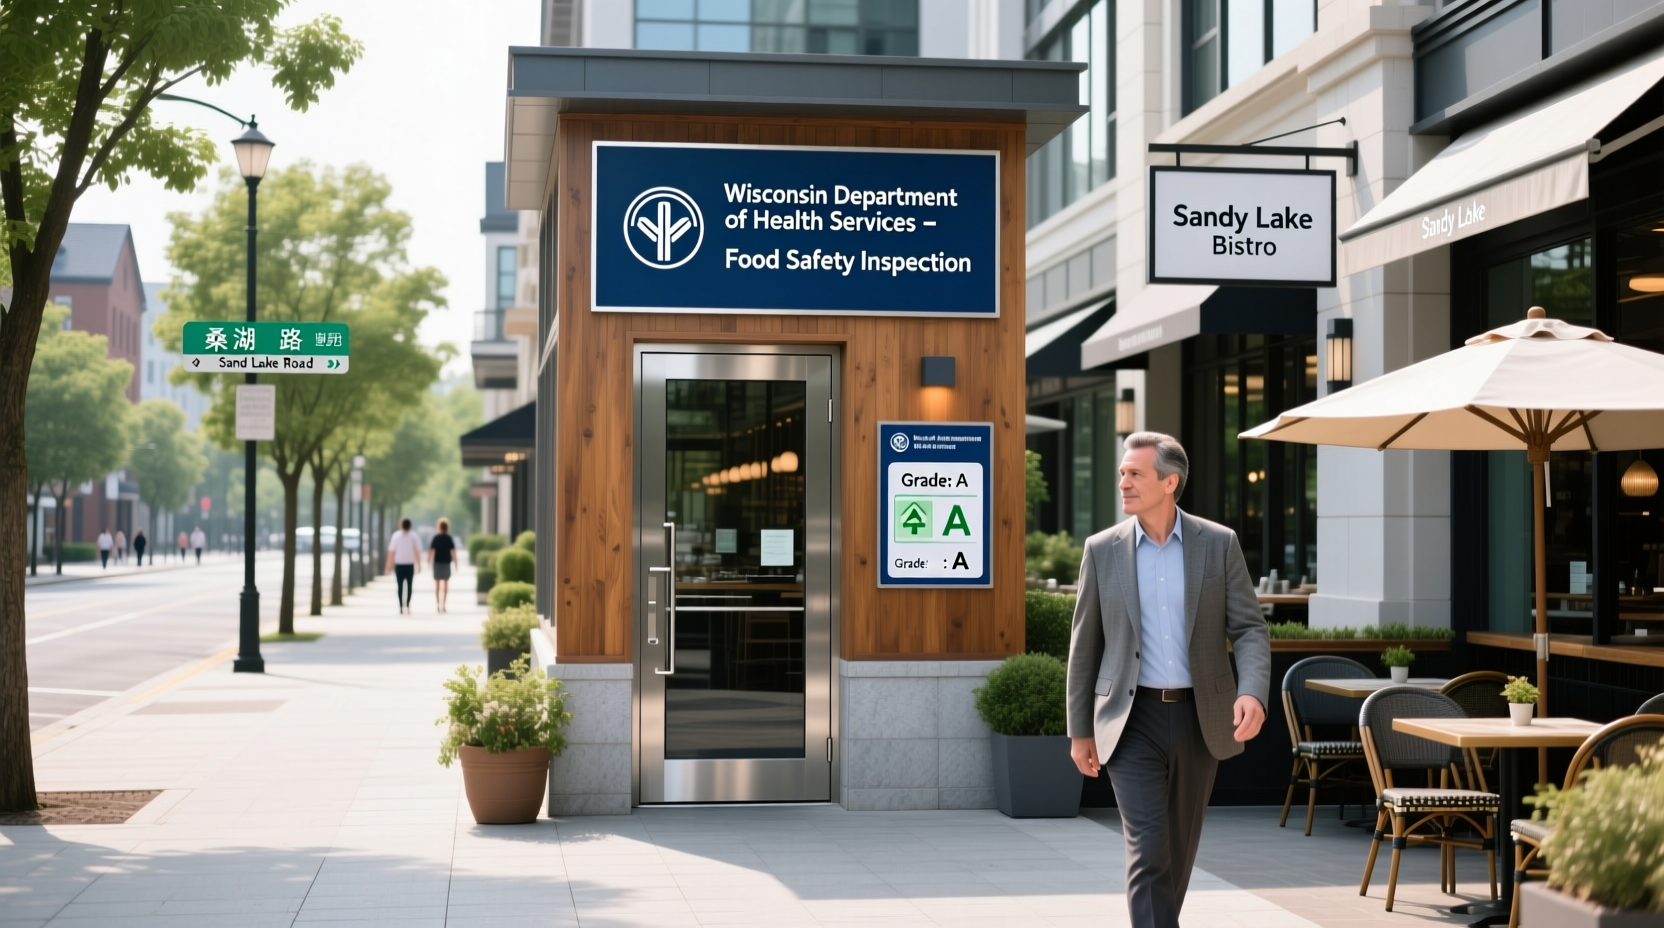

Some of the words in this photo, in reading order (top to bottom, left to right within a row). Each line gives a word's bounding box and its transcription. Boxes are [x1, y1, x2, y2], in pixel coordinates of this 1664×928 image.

[723, 182, 828, 205] Wisconsin
[834, 184, 958, 211] Department
[724, 208, 748, 229] of
[753, 209, 823, 231] Health
[829, 210, 917, 233] Services
[1172, 203, 1249, 235] Sandy
[1256, 205, 1313, 230] Lake
[1421, 208, 1455, 240] Sandy
[1212, 234, 1277, 257] Bistro
[725, 248, 780, 270] Food
[786, 248, 856, 277] Safety
[861, 250, 971, 277] Inspection
[218, 356, 248, 369] Sand
[251, 356, 279, 369] Lake
[283, 356, 314, 369] Road
[901, 472, 952, 488] Grade:
[955, 472, 969, 488] A
[942, 504, 971, 537] A
[951, 551, 970, 570] A
